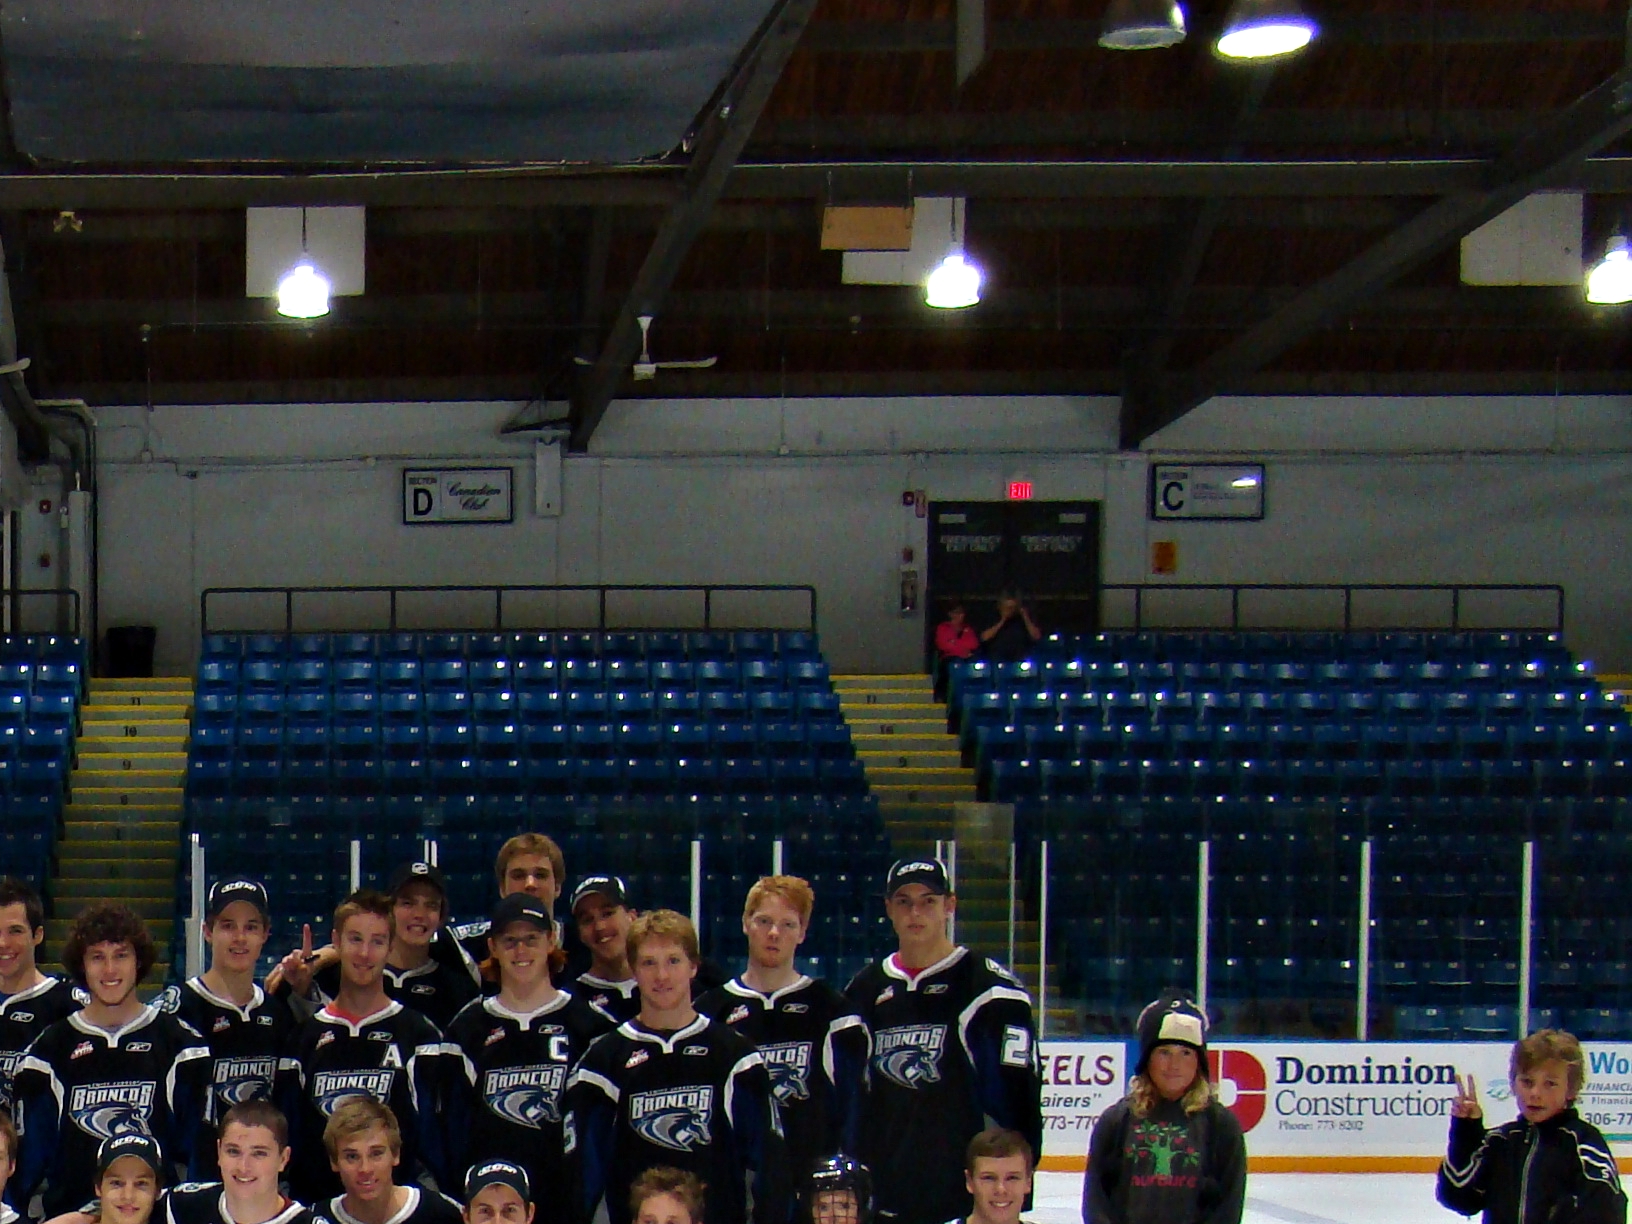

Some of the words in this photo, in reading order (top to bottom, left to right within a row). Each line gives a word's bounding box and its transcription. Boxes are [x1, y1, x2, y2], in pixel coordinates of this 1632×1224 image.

[413, 488, 433, 516] D
[1162, 481, 1184, 511] C
[381, 1044, 403, 1068] A
[1000, 1025, 1031, 1067] 2
[316, 1071, 391, 1096] BRONCOS
[486, 1068, 564, 1095] BRONCOS
[1275, 1056, 1456, 1084] Dominion
[72, 1084, 154, 1110] BRONCOS
[631, 1088, 711, 1119] BRONCOS
